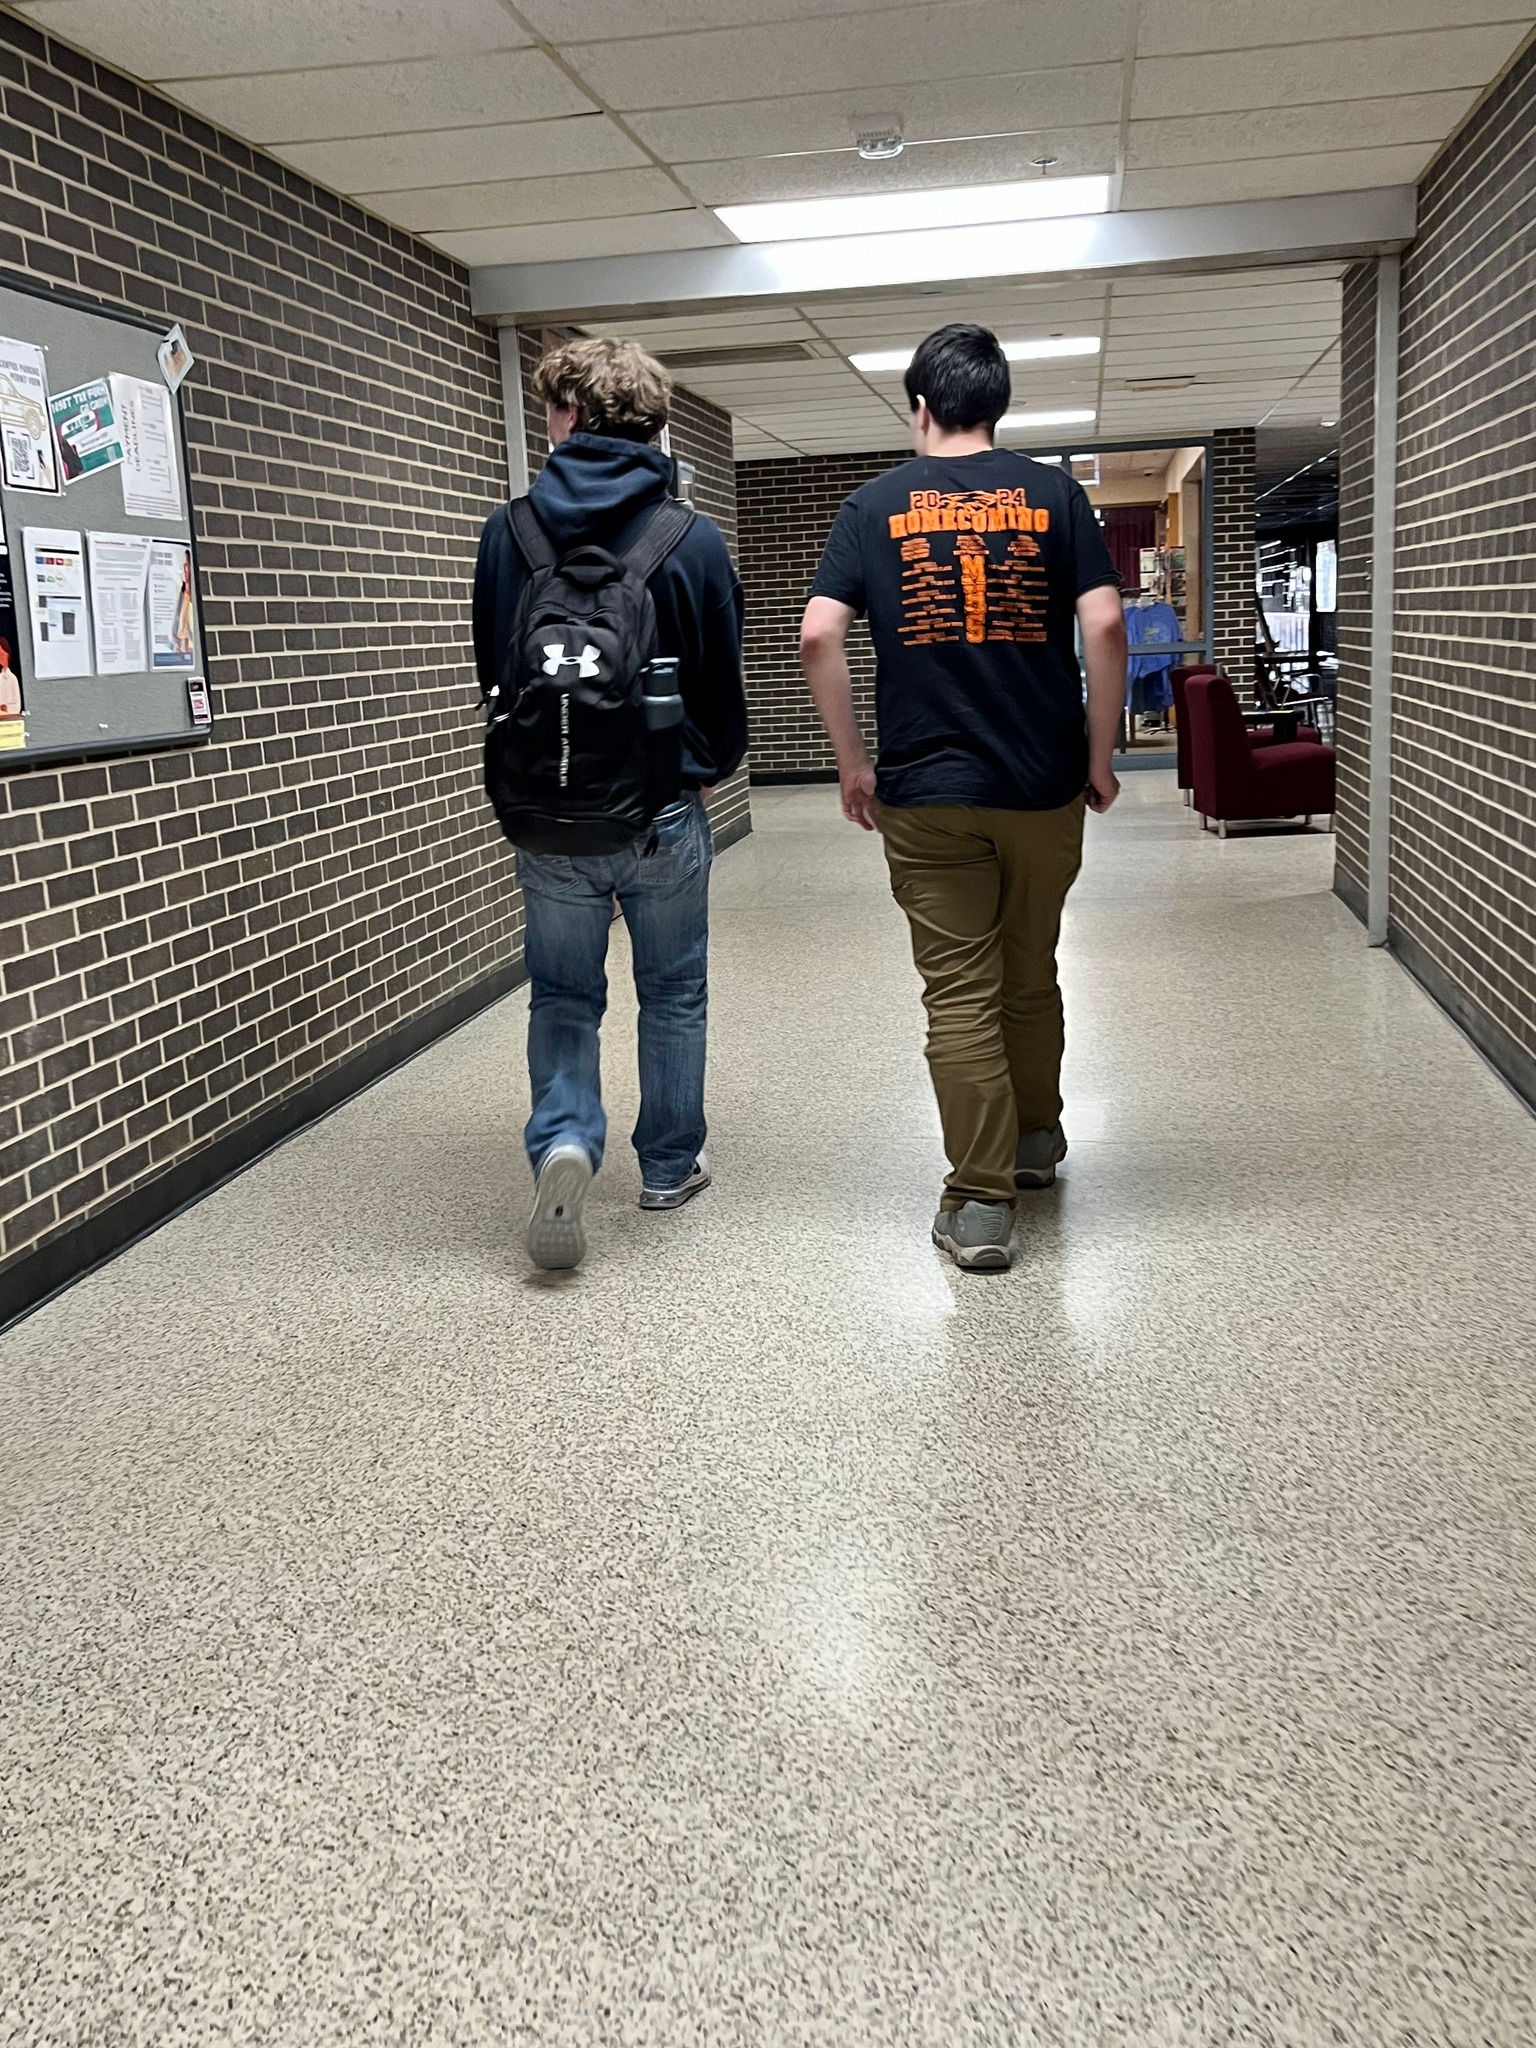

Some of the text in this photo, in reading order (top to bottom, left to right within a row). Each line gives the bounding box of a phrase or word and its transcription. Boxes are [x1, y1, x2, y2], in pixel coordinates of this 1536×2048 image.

[121, 403, 133, 466] PAYMENT
[129, 400, 141, 472] DEADLINES
[888, 506, 1050, 540] HOMECOMING
[909, 488, 1026, 509] 20 24
[560, 693, 571, 787] UNDER ARMOUR
